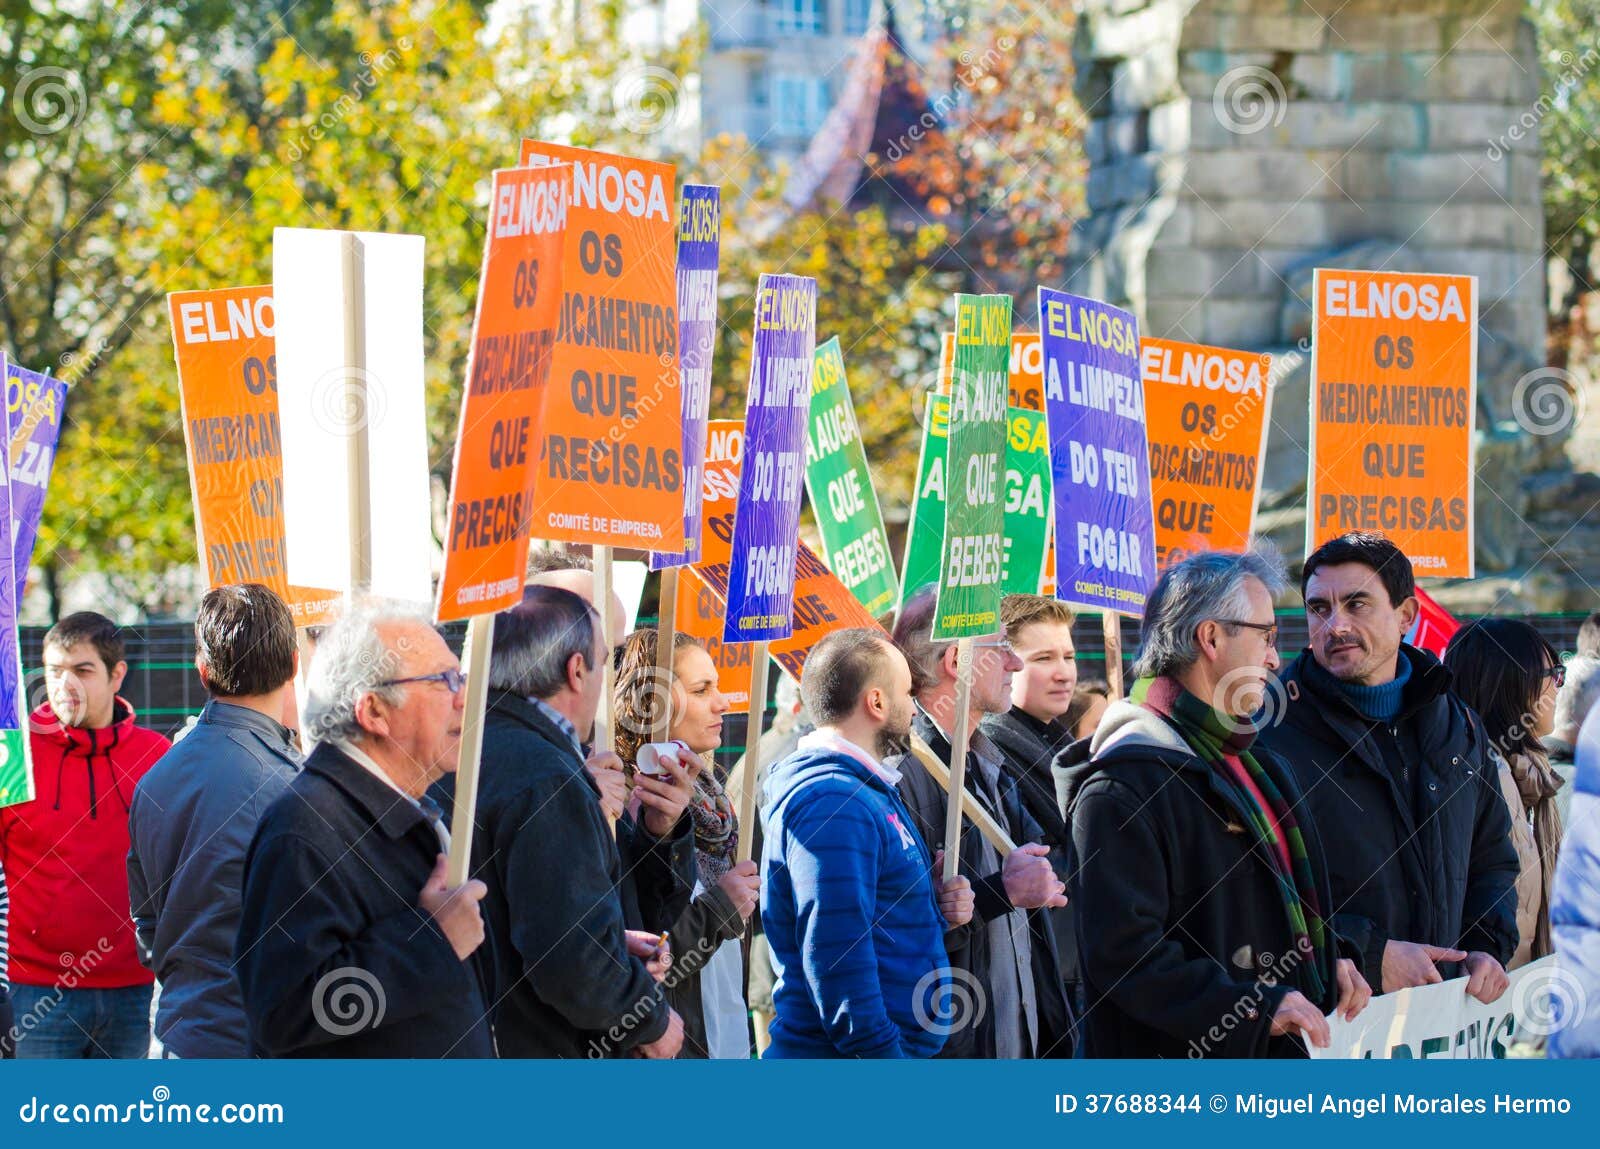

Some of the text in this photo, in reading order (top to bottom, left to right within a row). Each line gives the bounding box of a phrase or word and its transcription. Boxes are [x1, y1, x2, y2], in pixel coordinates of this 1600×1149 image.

[496, 179, 567, 238] ELNOSA
[528, 153, 669, 222] NOSA
[579, 230, 623, 278] OS
[513, 259, 538, 309] OS
[1325, 279, 1466, 323] ELNOSA
[180, 296, 275, 344] ELNO
[958, 304, 1010, 347] ELNOSA
[1047, 300, 1138, 359] ELNOSA
[1141, 346, 1263, 398] ELNOSA
[1373, 335, 1414, 370] OS
[571, 369, 637, 419] QUE
[951, 370, 969, 422] A
[1047, 358, 1064, 402] A
[1069, 364, 1145, 424] LIMPEZA
[1320, 382, 1467, 428] MEDICAMENTOS
[490, 416, 530, 470] QUE
[815, 400, 859, 461] AUGA
[1181, 402, 1217, 435] OS
[541, 434, 680, 492] RECISAS
[752, 452, 774, 502] DO
[965, 453, 997, 508] QUE
[1069, 440, 1138, 498] DO TEU
[1148, 442, 1256, 491] DICAMENTOS
[1362, 443, 1424, 478] QUE
[828, 467, 865, 524] QUE
[1158, 498, 1215, 534] QUE
[1319, 495, 1467, 532] PRECISAS
[548, 512, 663, 539] COMITÉ DE EMPRESA
[1077, 521, 1142, 578] FOGAR
[745, 545, 792, 597] FOGAR
[833, 527, 886, 588] BEBES
[947, 533, 1000, 588] BEBES
